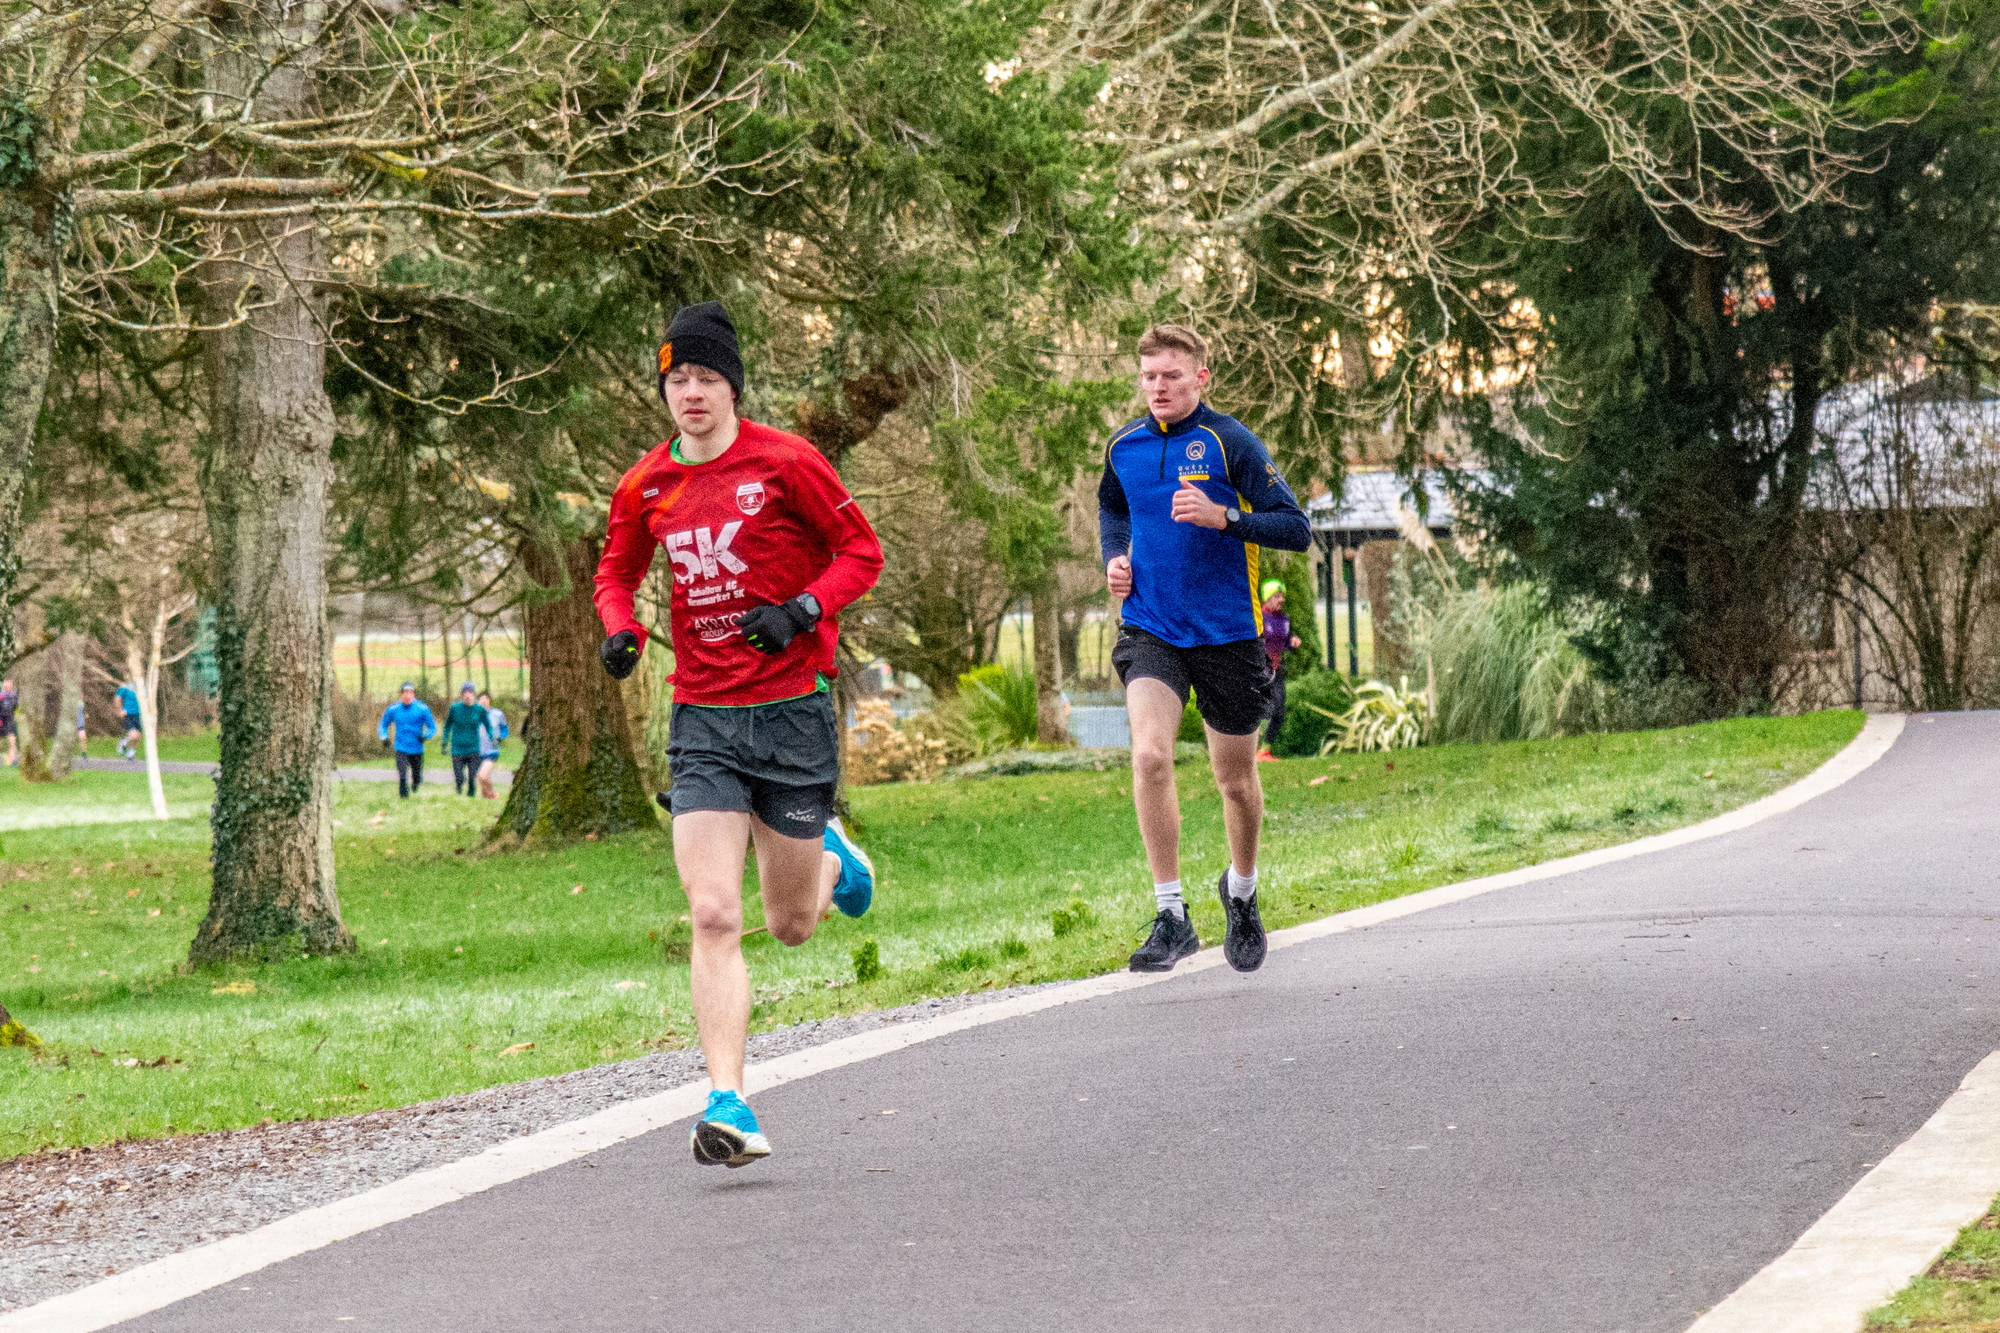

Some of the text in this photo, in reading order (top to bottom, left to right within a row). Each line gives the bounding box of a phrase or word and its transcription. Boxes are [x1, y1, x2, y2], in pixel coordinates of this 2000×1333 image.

[666, 520, 749, 585] 5K
[725, 580, 738, 591] AC
[733, 588, 745, 599] 5K
[694, 610, 747, 630] AYRTO
[700, 628, 725, 639] GROUP
